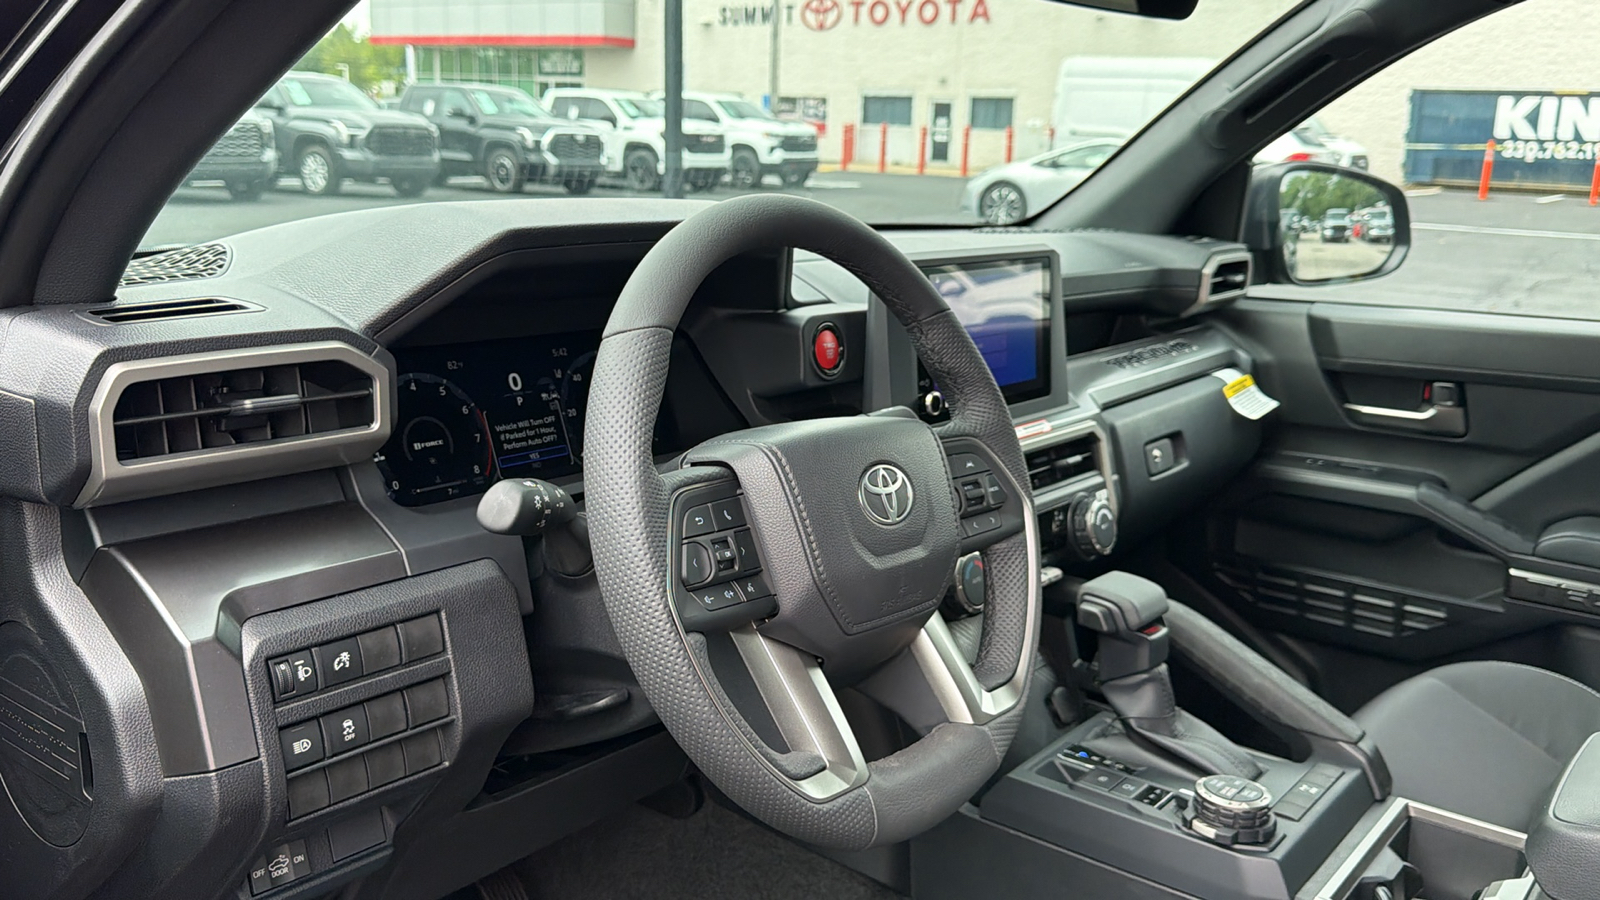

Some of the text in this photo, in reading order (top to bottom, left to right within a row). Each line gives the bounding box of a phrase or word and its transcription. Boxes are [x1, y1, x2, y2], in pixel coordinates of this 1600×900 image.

[718, 0, 990, 26] SUMMT TOYOTA
[552, 348, 567, 357] 5:42
[508, 372, 522, 391] 0
[573, 373, 582, 381] 40
[409, 382, 417, 391] 4
[439, 386, 447, 396] 5
[517, 396, 523, 406] P
[462, 405, 469, 414] 6
[567, 408, 577, 417] 20
[495, 423, 517, 432] Vehicle
[517, 420, 530, 428] Will
[544, 415, 556, 424] OFF
[474, 433, 481, 443] 7
[505, 431, 526, 440] Parked
[503, 434, 558, 450] Perform Auto OFF?
[473, 464, 480, 474] 8
[392, 481, 399, 490] 0
[344, 733, 356, 741] OFF
[293, 853, 305, 864] ON
[252, 868, 265, 879] OFF
[271, 866, 289, 878] DOOR
